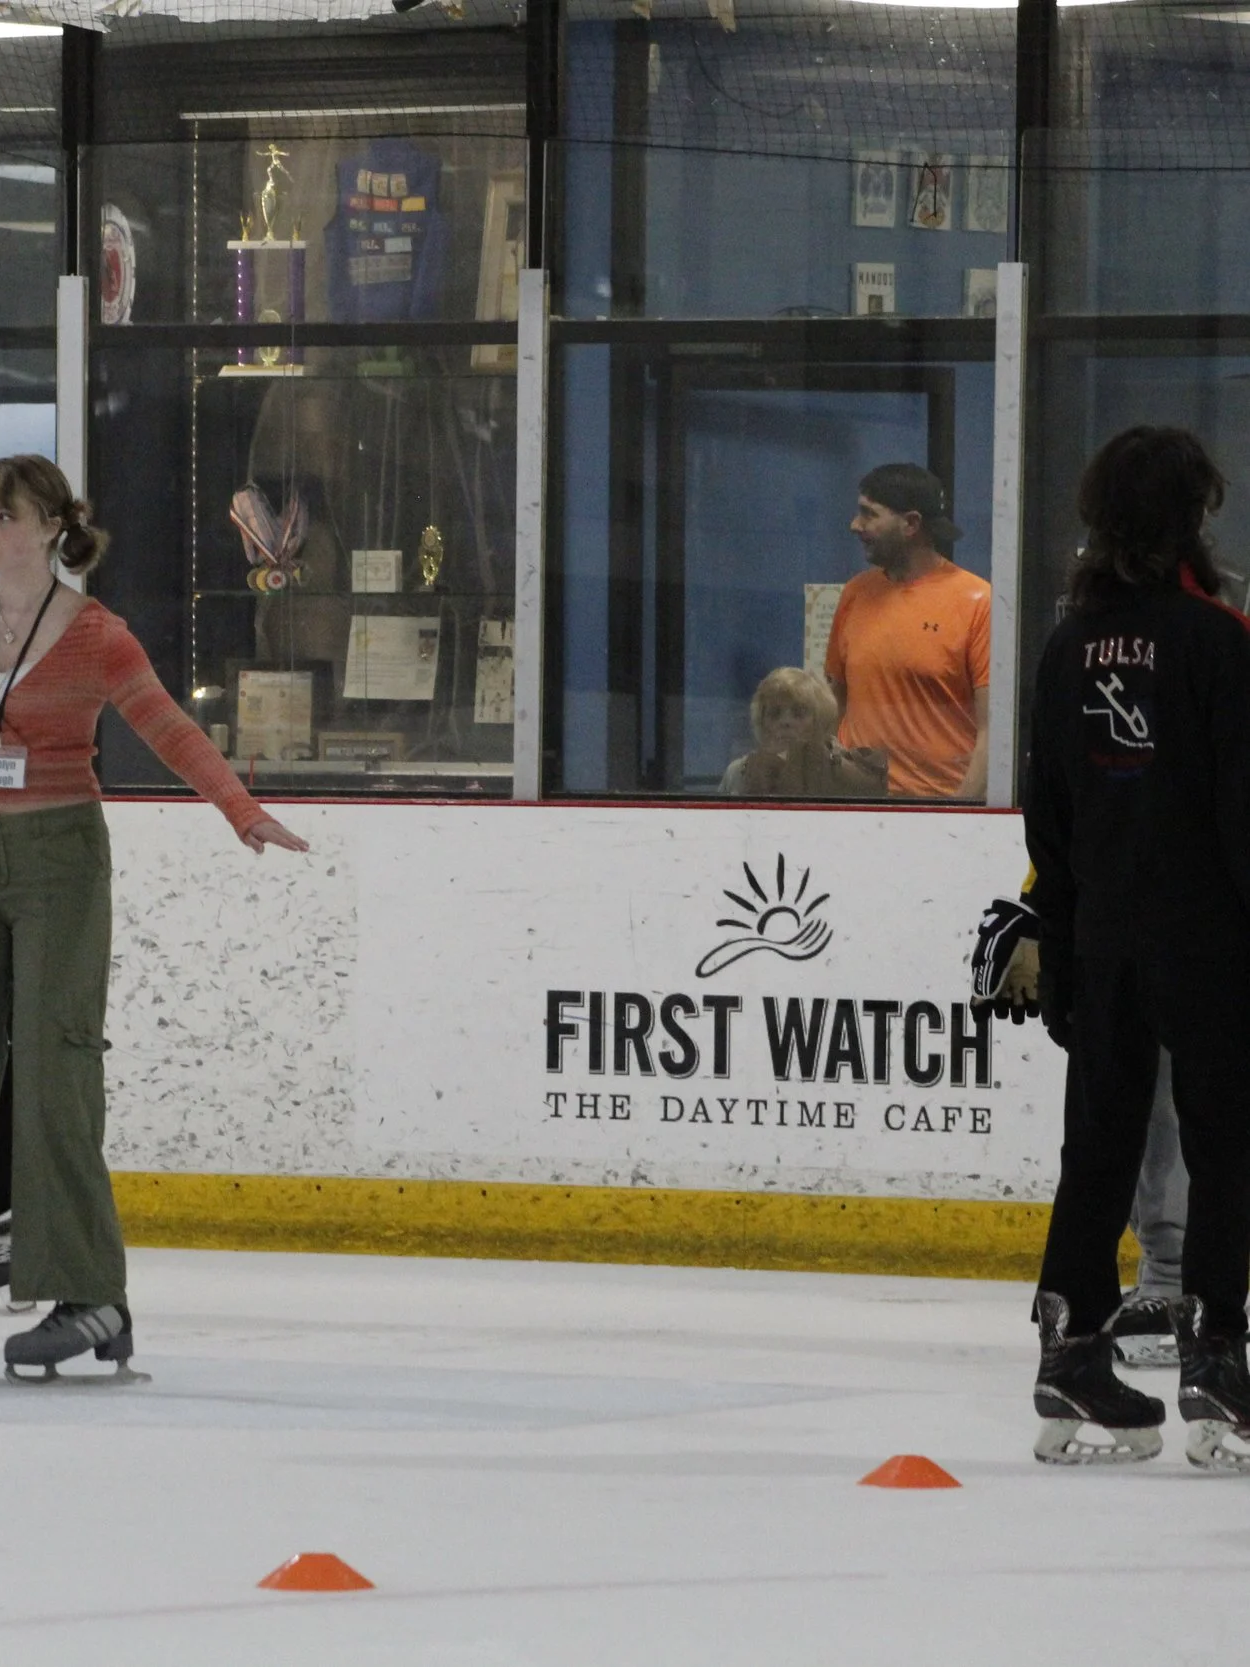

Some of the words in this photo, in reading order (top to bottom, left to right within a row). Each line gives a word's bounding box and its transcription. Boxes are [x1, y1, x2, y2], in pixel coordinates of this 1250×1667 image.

[1083, 635, 1155, 671] TULSA
[546, 989, 742, 1079] FIRST
[547, 1092, 632, 1120] THE
[660, 1096, 856, 1130] DAYTIME
[884, 1104, 993, 1134] CAFE
